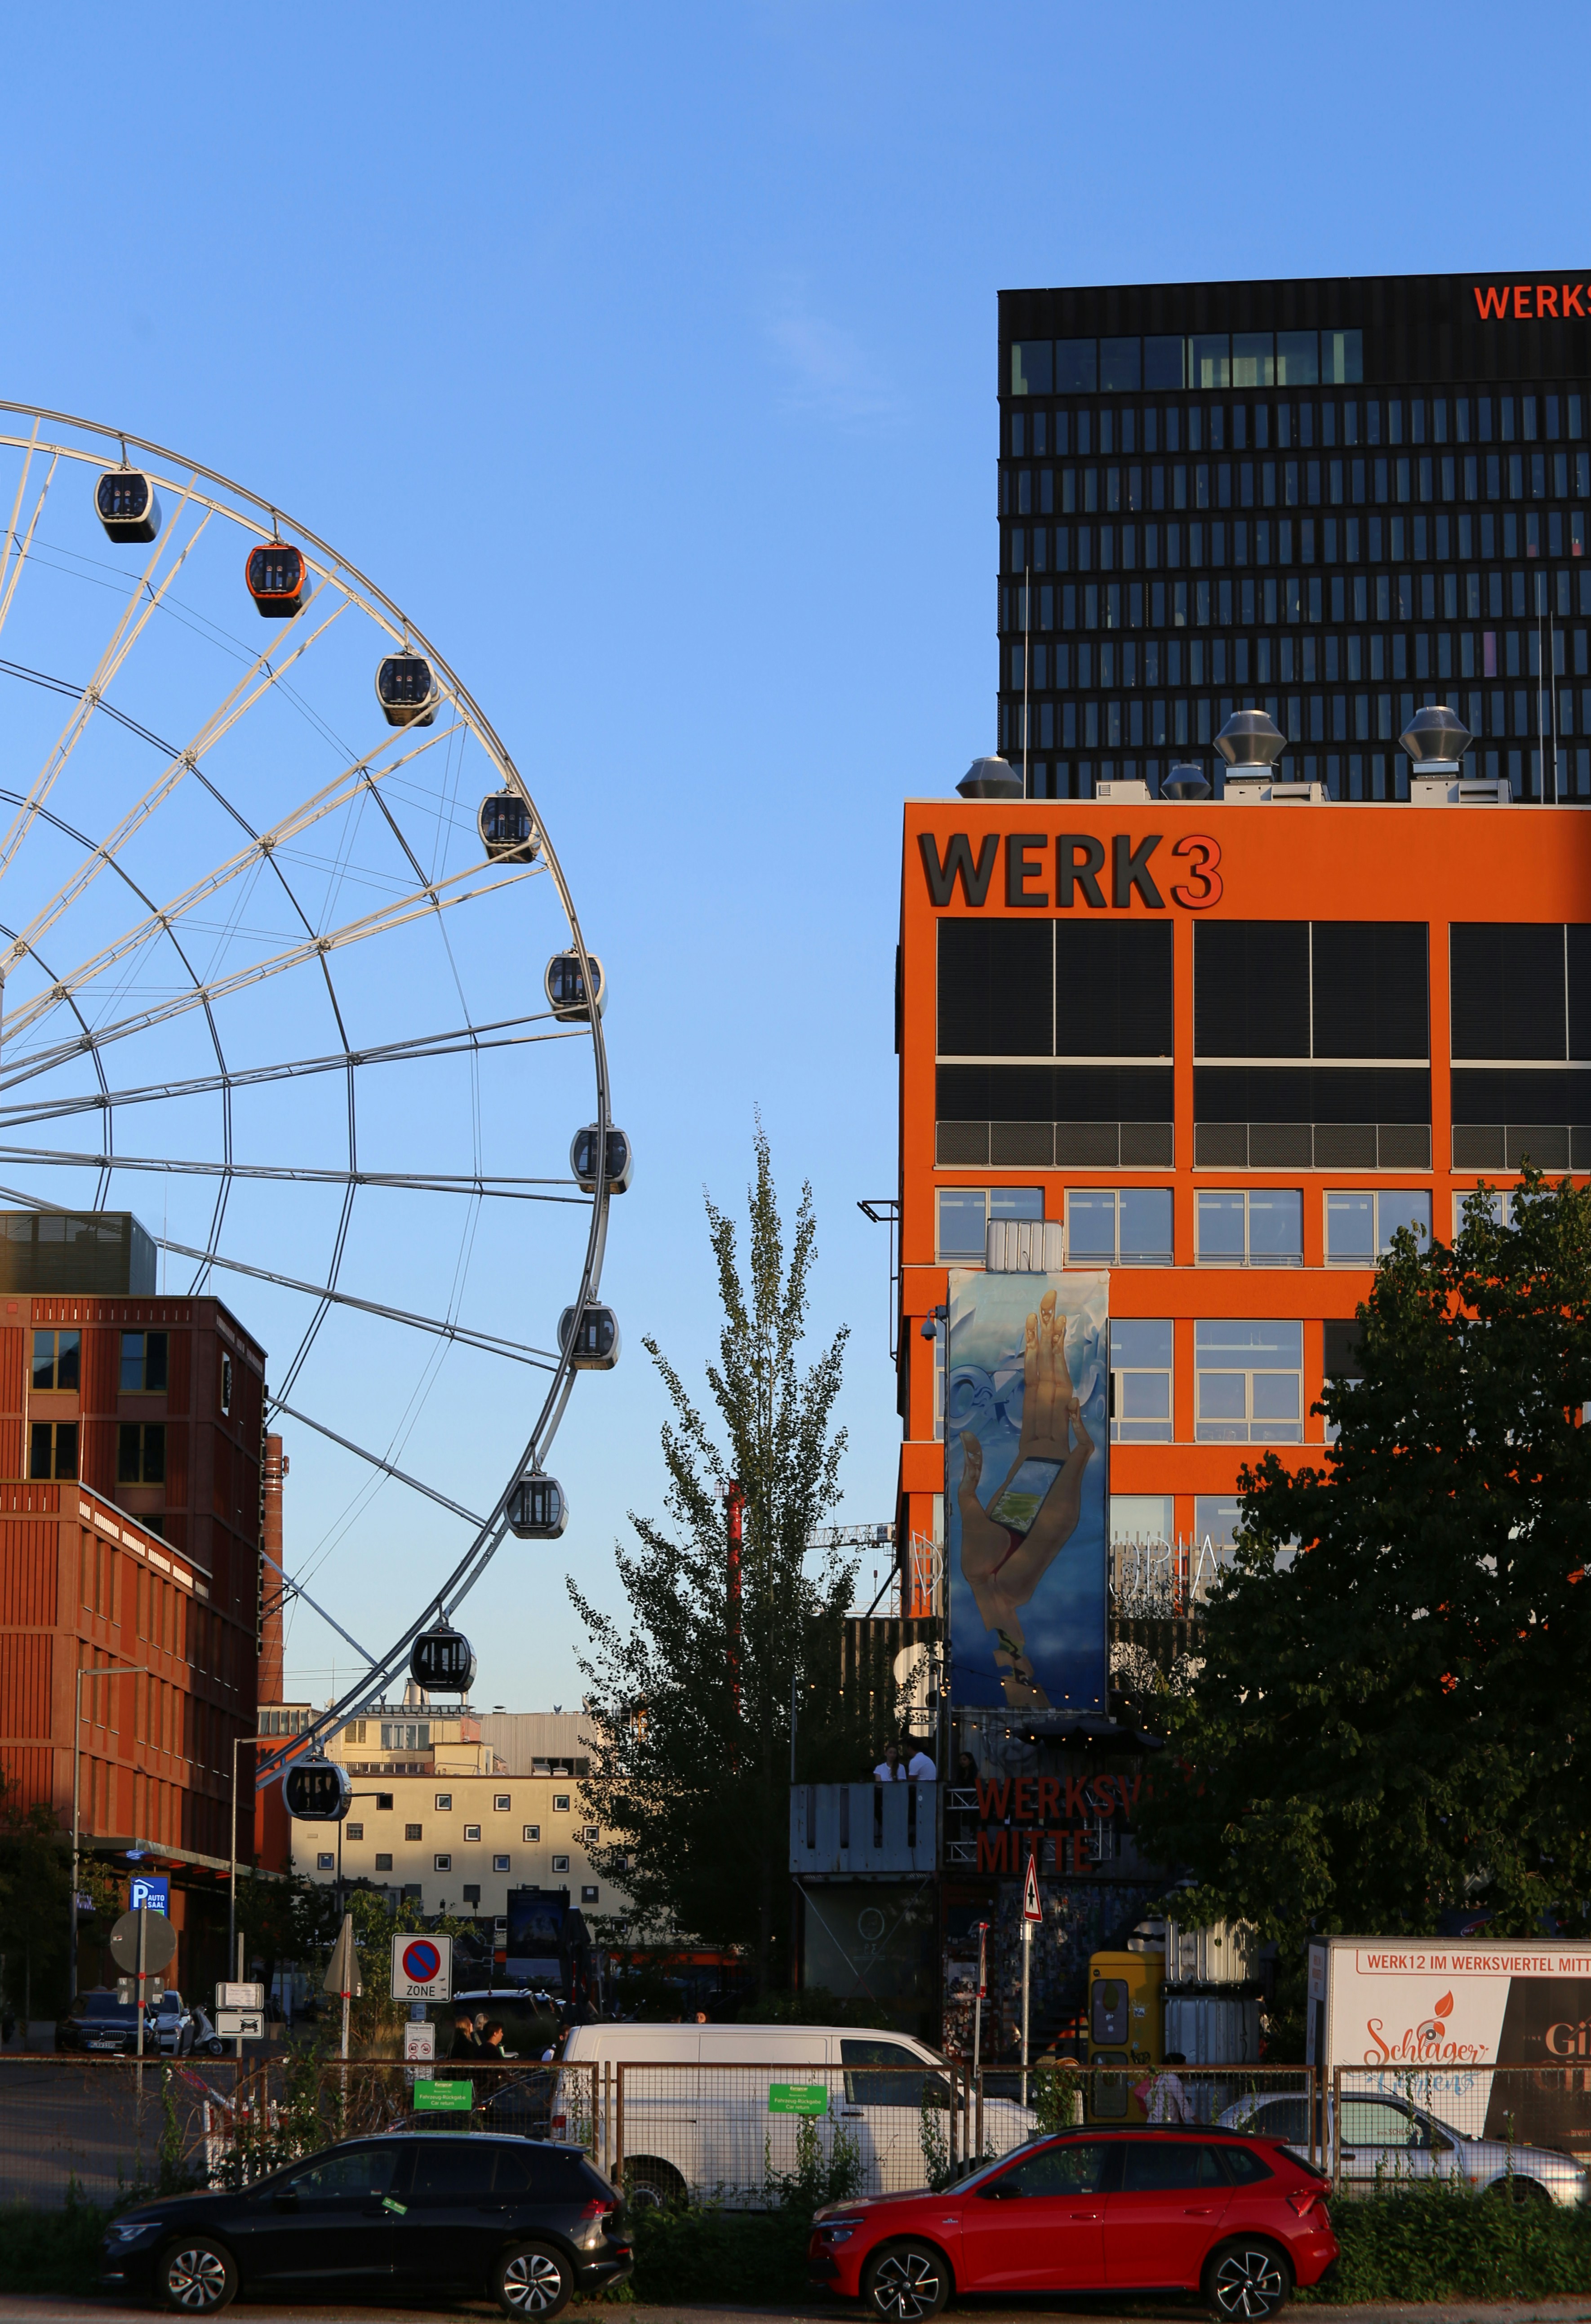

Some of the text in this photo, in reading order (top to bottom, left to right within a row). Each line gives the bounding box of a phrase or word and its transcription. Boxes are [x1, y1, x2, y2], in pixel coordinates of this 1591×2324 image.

[1474, 284, 1591, 319] WERK
[976, 1830, 1094, 1873] MITTE
[1367, 1955, 1591, 1972] WERK12 IM WERKSVIERTEL MITT
[406, 1985, 436, 1996] ZONE
[1364, 2018, 1486, 2066] Schlager
[1546, 2021, 1591, 2056] Gi
